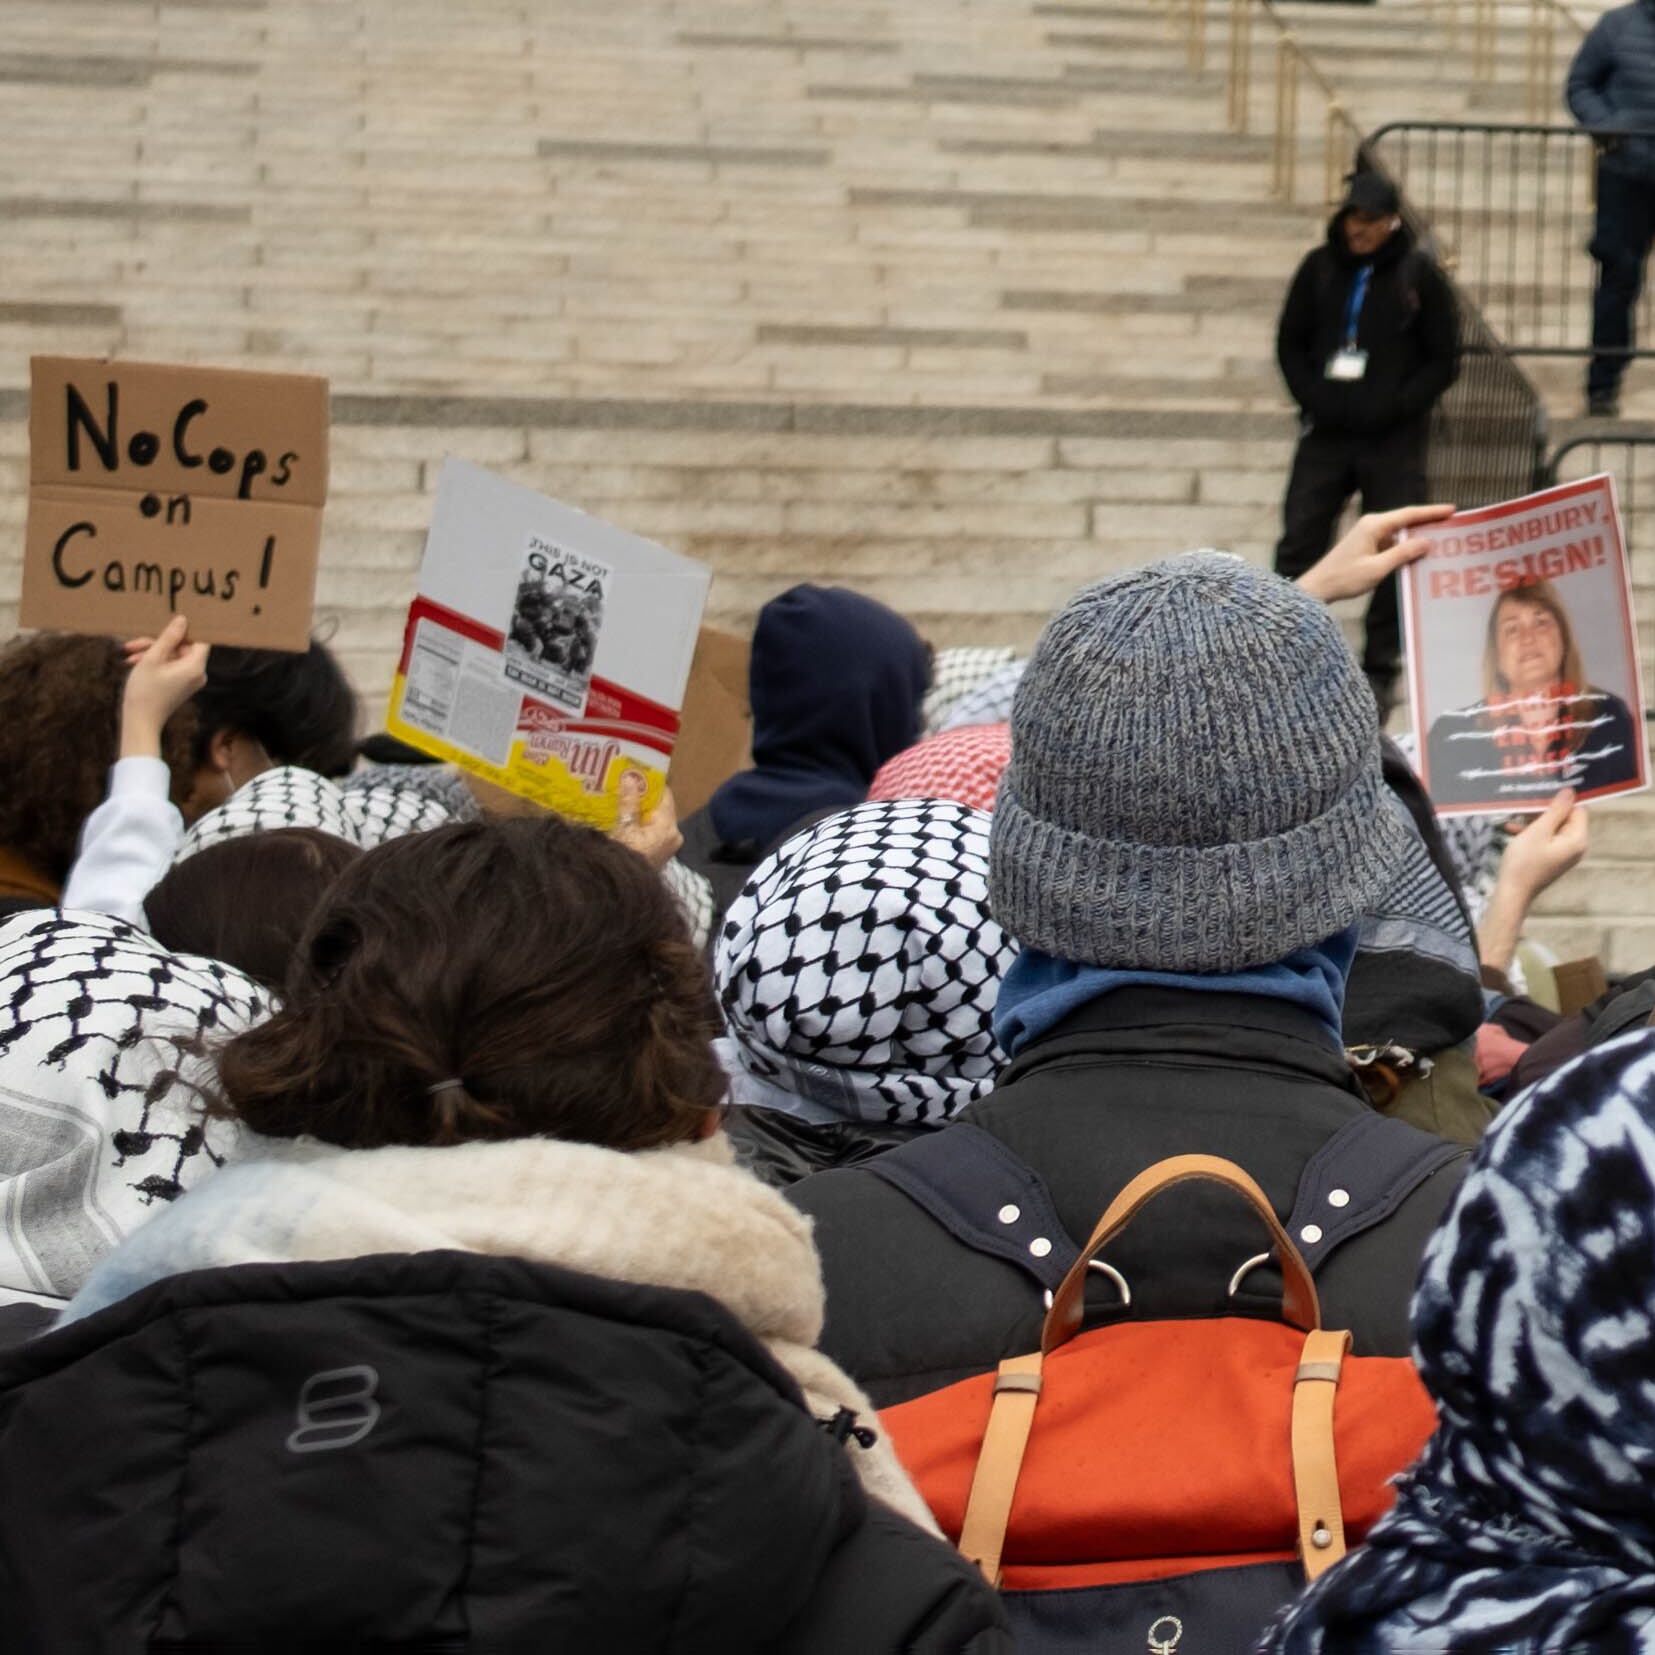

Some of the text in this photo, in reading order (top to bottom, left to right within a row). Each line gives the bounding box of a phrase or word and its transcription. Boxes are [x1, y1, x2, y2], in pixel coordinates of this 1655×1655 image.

[65, 381, 299, 499] No Cops
[139, 491, 191, 524] on
[528, 552, 604, 600] GAZA
[581, 559, 608, 578] NOT
[1429, 534, 1607, 599] RESIGN!
